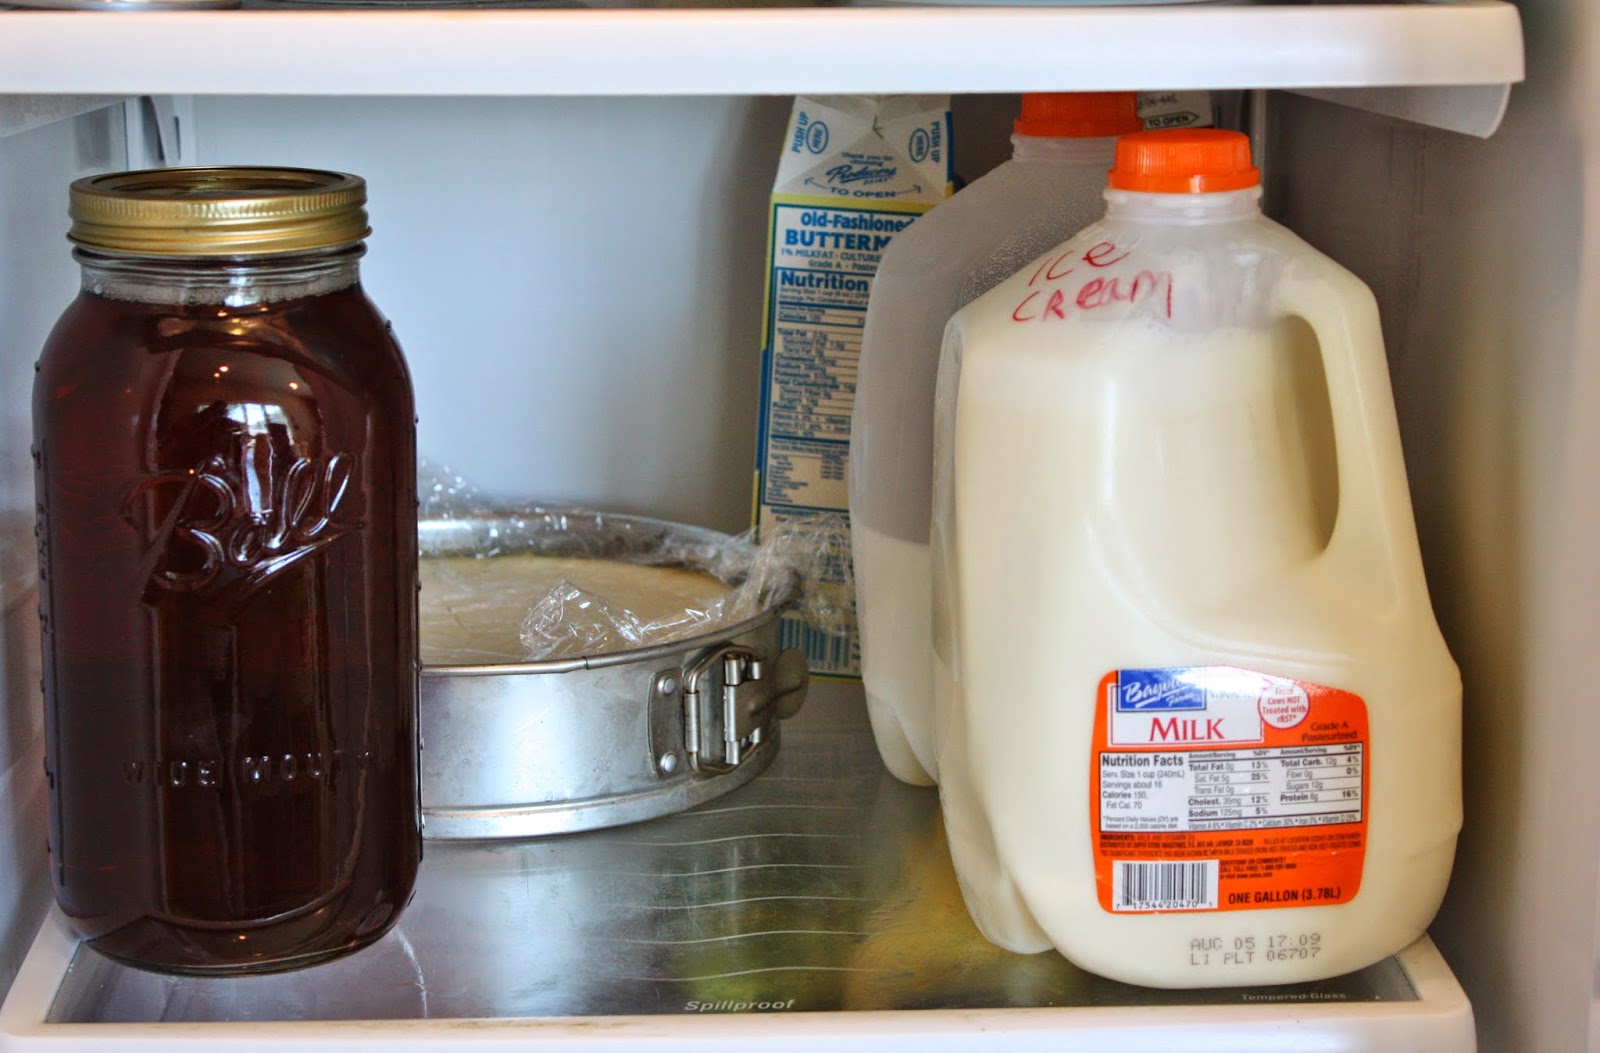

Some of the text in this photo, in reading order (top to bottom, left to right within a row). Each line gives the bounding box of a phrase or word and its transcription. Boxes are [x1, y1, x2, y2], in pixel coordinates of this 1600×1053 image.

[1148, 115, 1190, 127] TO OPEN
[791, 111, 809, 153] PUSH UP
[931, 121, 940, 163] PUSH UP
[830, 186, 896, 198] TO OPEN
[795, 249, 834, 259] MILKFAT
[808, 259, 833, 268] Grade
[835, 261, 842, 269] A
[780, 270, 869, 292] Nutrition
[1267, 696, 1301, 705] Cows NOT
[1262, 705, 1307, 714] Treated with
[1149, 717, 1225, 742] MILK
[1310, 721, 1349, 731] Grade A
[1301, 731, 1358, 742] Pasteurized
[1188, 751, 1236, 759] Amount/Serving
[1280, 747, 1328, 755] Amount/Serving
[1101, 754, 1184, 767] Nutrition Facts
[1280, 759, 1300, 767] Total
[1302, 758, 1323, 766] Carb.
[1325, 757, 1338, 767] 12g
[242, 751, 371, 784] MOU
[1188, 763, 1209, 771] Total
[1211, 763, 1224, 771] Fat
[1102, 770, 1119, 779] Serv.
[1120, 770, 1136, 779] Size
[1142, 771, 1156, 780] cup
[1156, 769, 1185, 779] (240mL)
[1209, 774, 1220, 782] Fat
[1221, 773, 1230, 784] 5g
[1286, 770, 1303, 779] Fiber
[1304, 770, 1313, 780] 0g
[1102, 780, 1163, 790] Servings about 16
[1286, 781, 1324, 792] Sugars 12g
[1102, 791, 1132, 799] Calories
[1194, 785, 1235, 796] Trans Fat 0g
[1188, 797, 1222, 807] Cholest.
[1222, 797, 1242, 807] 35mg
[1280, 794, 1308, 802] Protein
[1106, 801, 1143, 809] Fat Cal. 70
[1188, 809, 1219, 818] Sodium
[1220, 808, 1243, 818] 125mg
[1228, 886, 1341, 905] ONE GALLON (3.78L)
[1189, 933, 1321, 951] AUG 05 17:09
[1223, 952, 1255, 965] PLT
[1266, 947, 1321, 962] 06707
[1242, 992, 1347, 1001] Tempered Glass
[684, 999, 796, 1013] Spillproof
